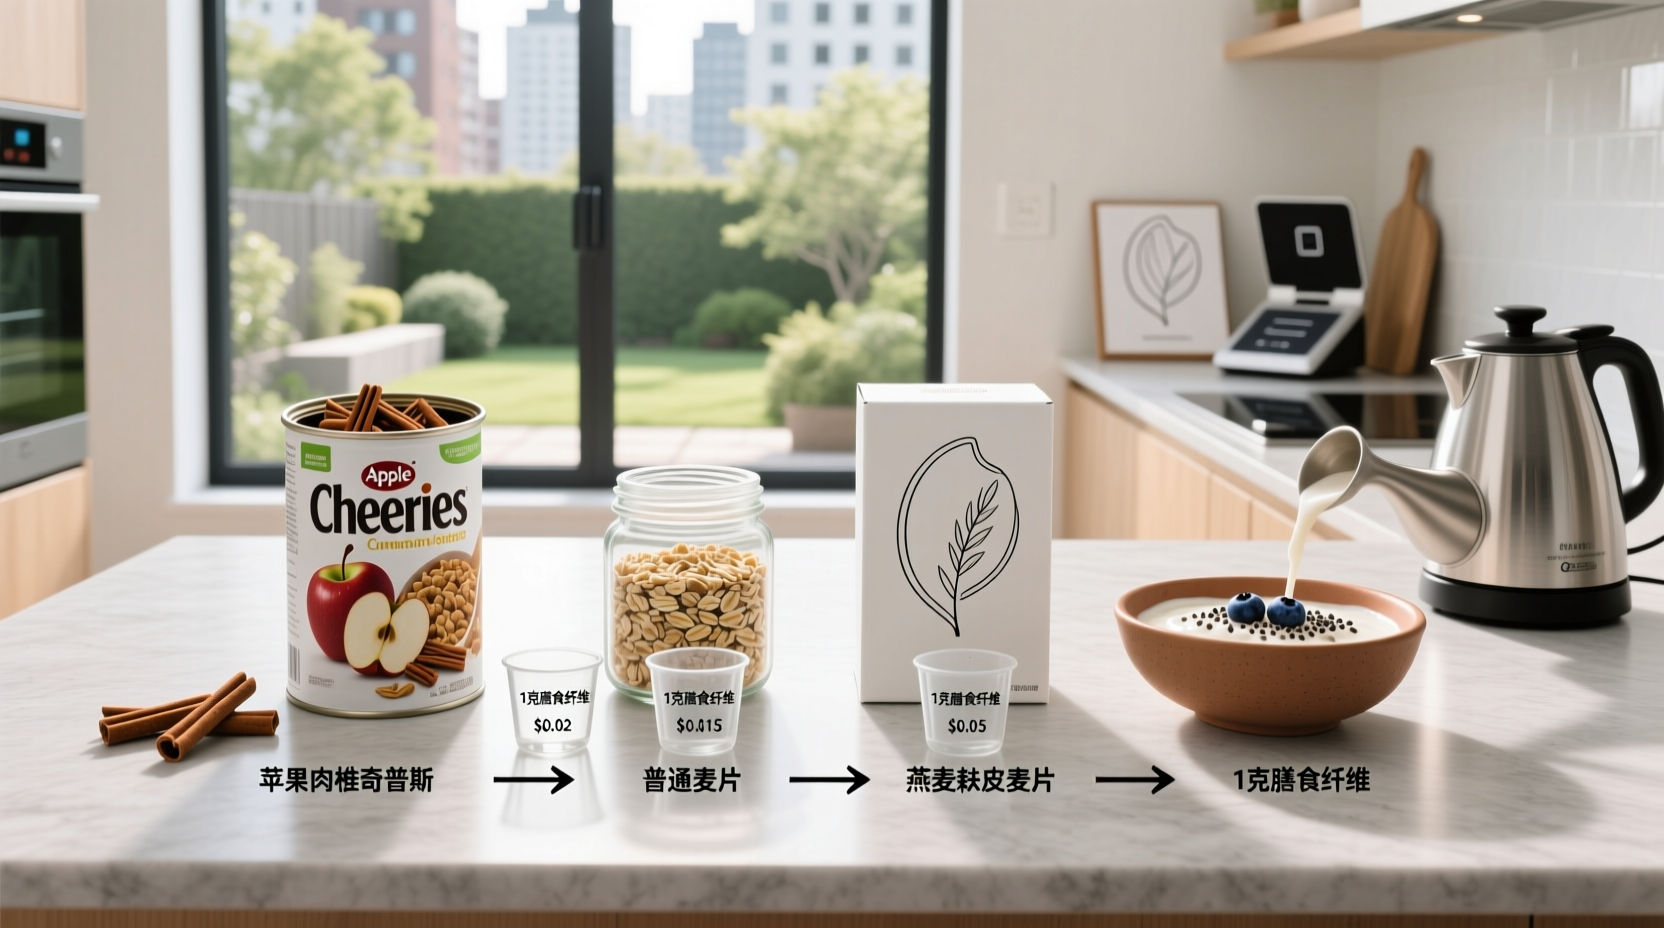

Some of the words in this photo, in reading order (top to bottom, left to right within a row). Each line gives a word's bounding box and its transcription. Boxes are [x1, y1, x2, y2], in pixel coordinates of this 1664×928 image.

[365, 466, 412, 487] Apple
[310, 482, 468, 535] Cheeries
[534, 717, 572, 734] $0.02
[948, 718, 987, 734] $0.05
